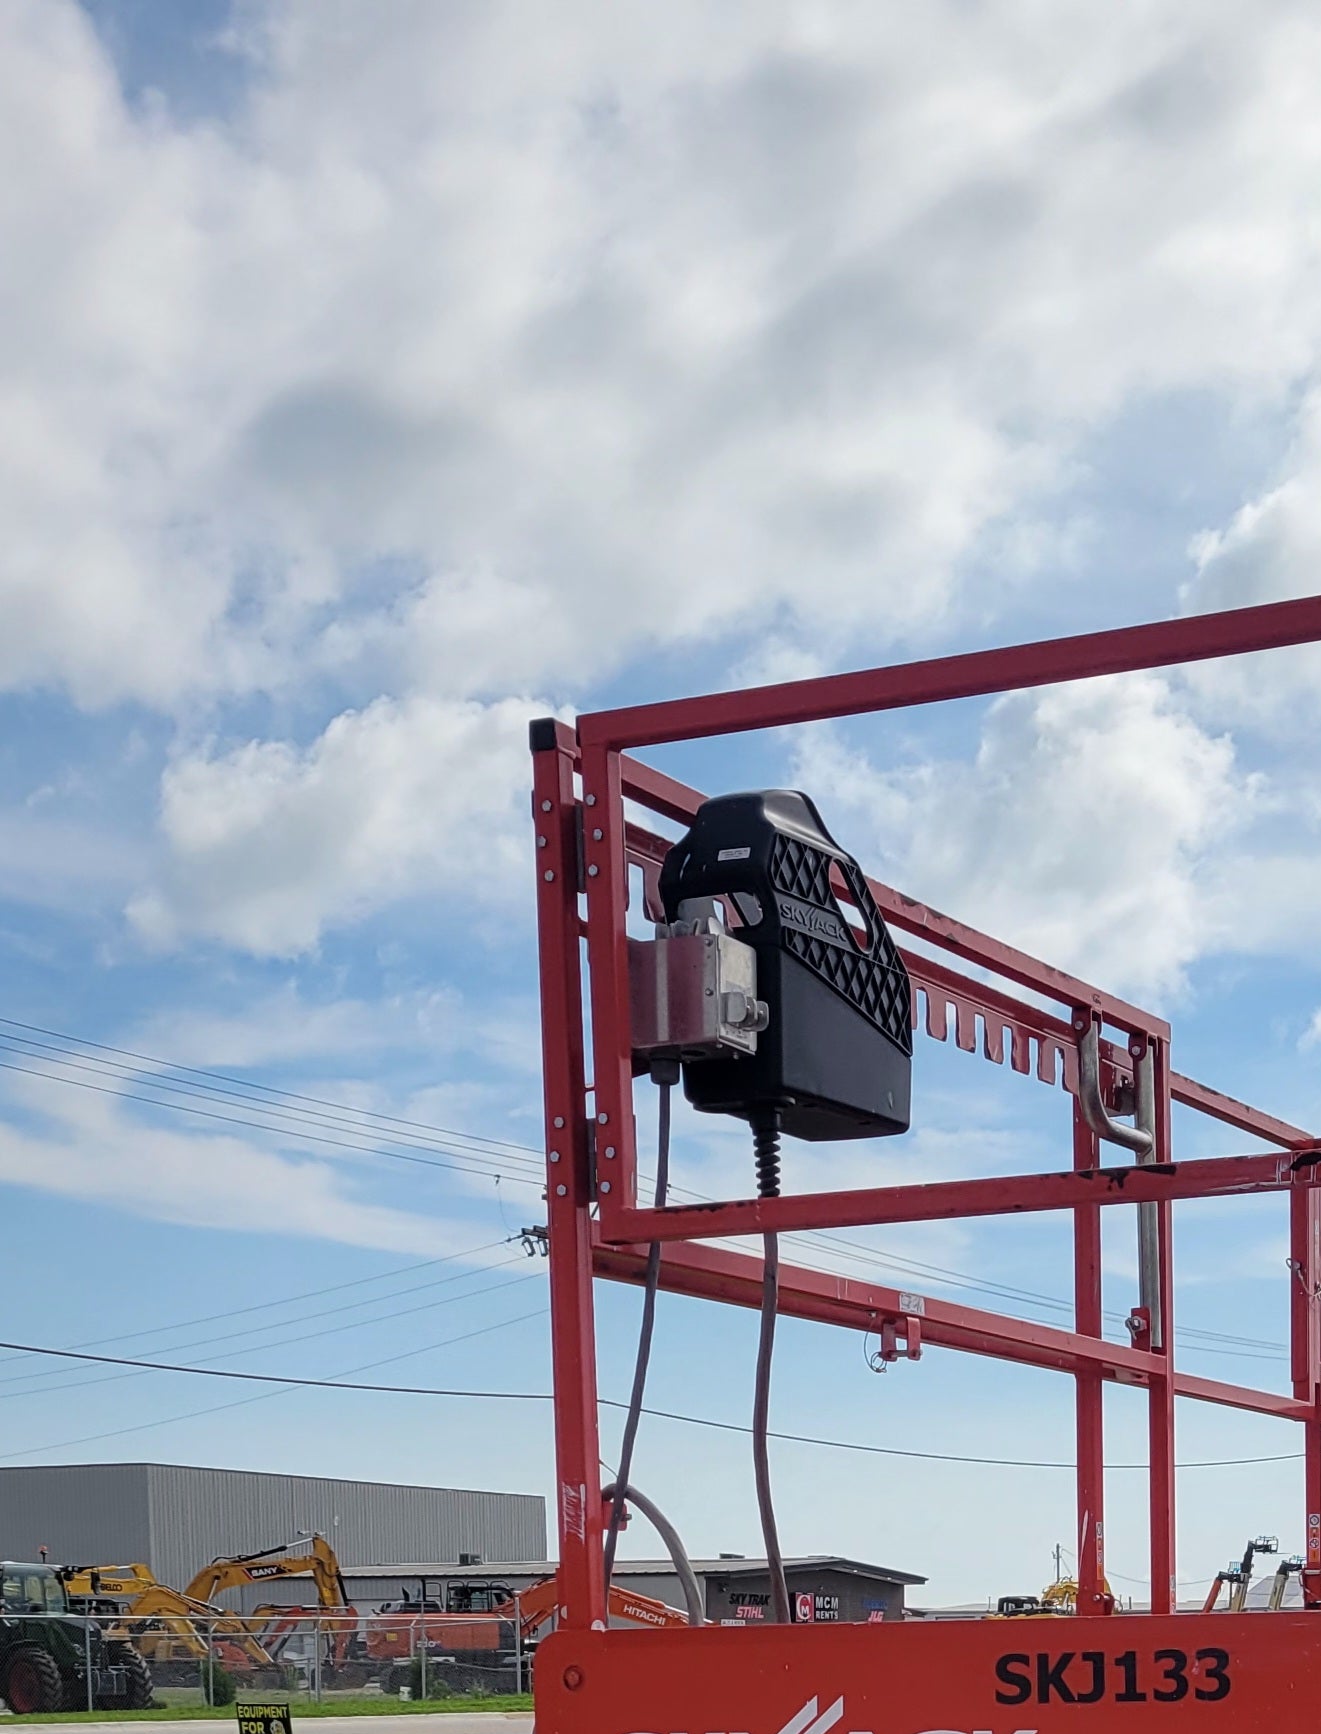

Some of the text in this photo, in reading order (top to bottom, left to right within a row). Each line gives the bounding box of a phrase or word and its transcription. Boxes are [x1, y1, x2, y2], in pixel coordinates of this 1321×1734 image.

[780, 903, 847, 942] SKYJACK
[251, 1566, 278, 1577] SANY
[729, 1593, 771, 1606] SKY TRAK
[815, 1596, 839, 1610] MCM
[623, 1604, 666, 1626] HITACHI
[735, 1606, 764, 1619] STIHL
[815, 1610, 839, 1620] RENTS
[995, 1648, 1231, 1705] SKJ133
[237, 1705, 288, 1719] EQUIPMENT
[241, 1721, 266, 1734] FOR
